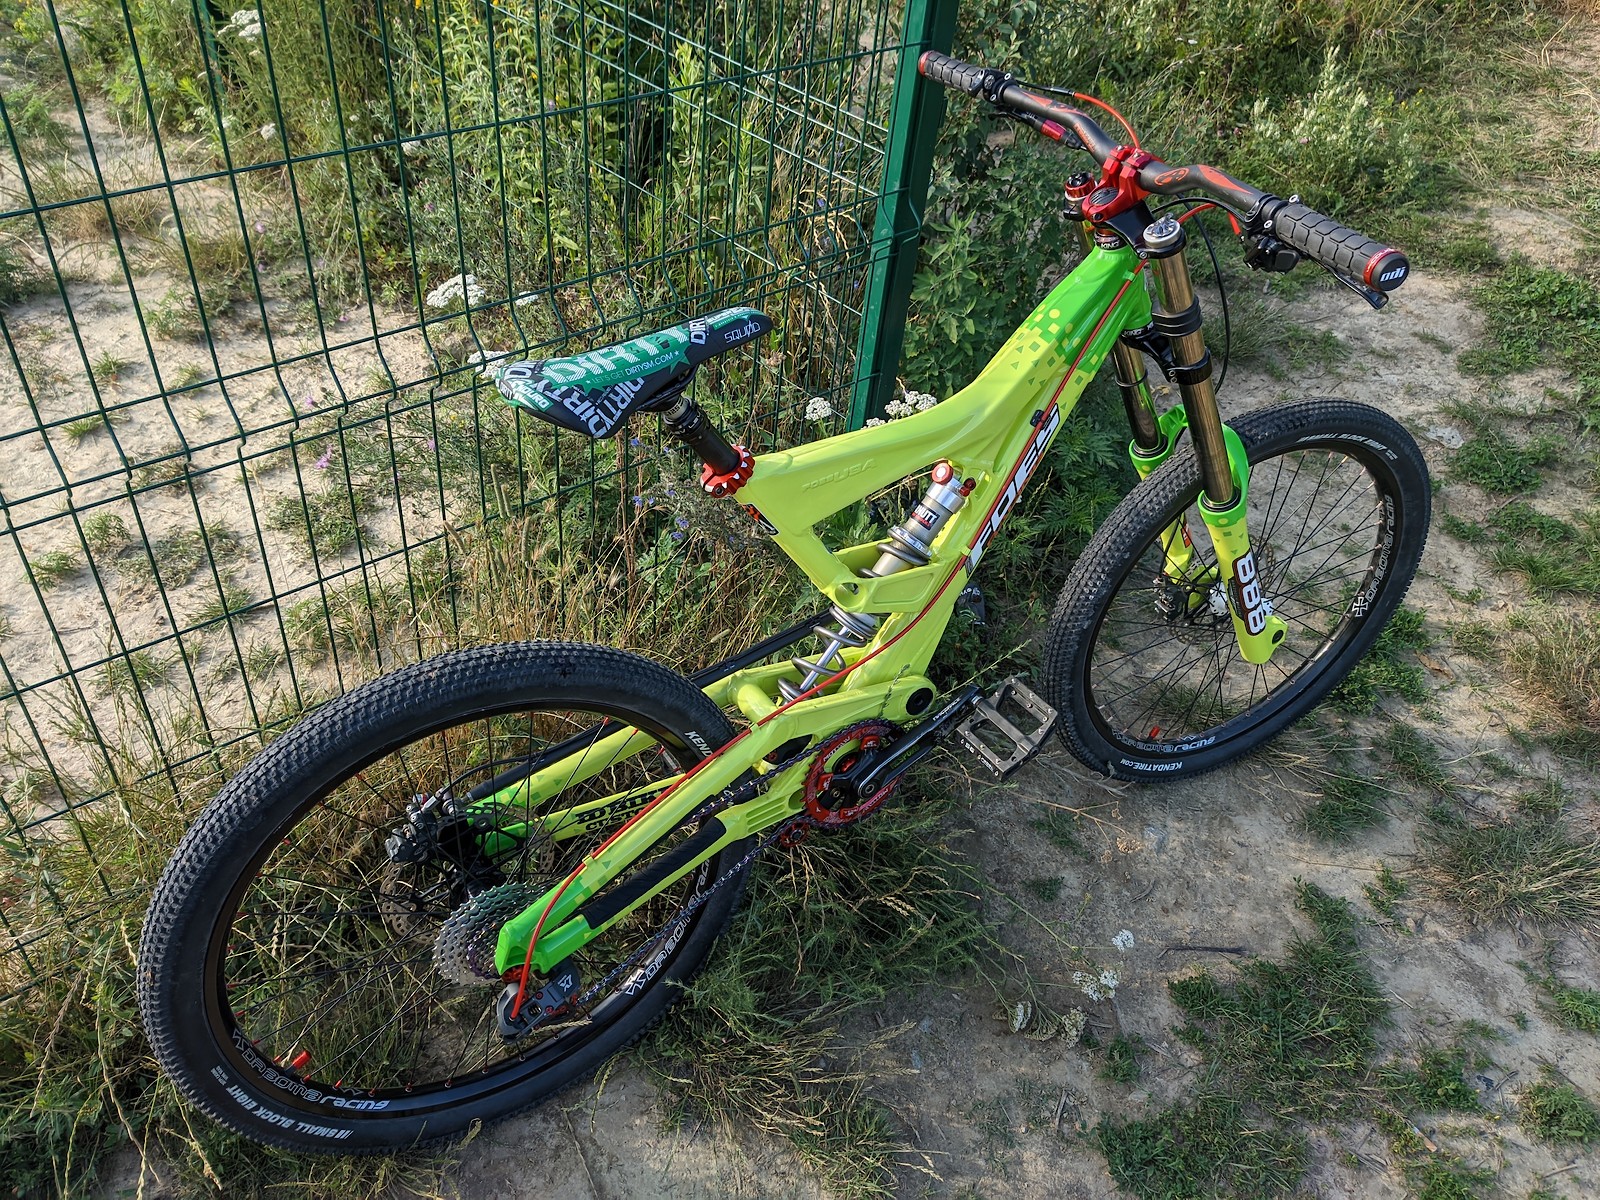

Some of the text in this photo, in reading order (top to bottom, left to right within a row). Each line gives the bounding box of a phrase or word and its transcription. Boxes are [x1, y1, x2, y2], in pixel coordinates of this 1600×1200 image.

[1236, 552, 1266, 634] 888
[684, 730, 714, 757] KEND
[226, 1084, 259, 1111] EIGHT
[252, 1106, 296, 1129] BLOCK
